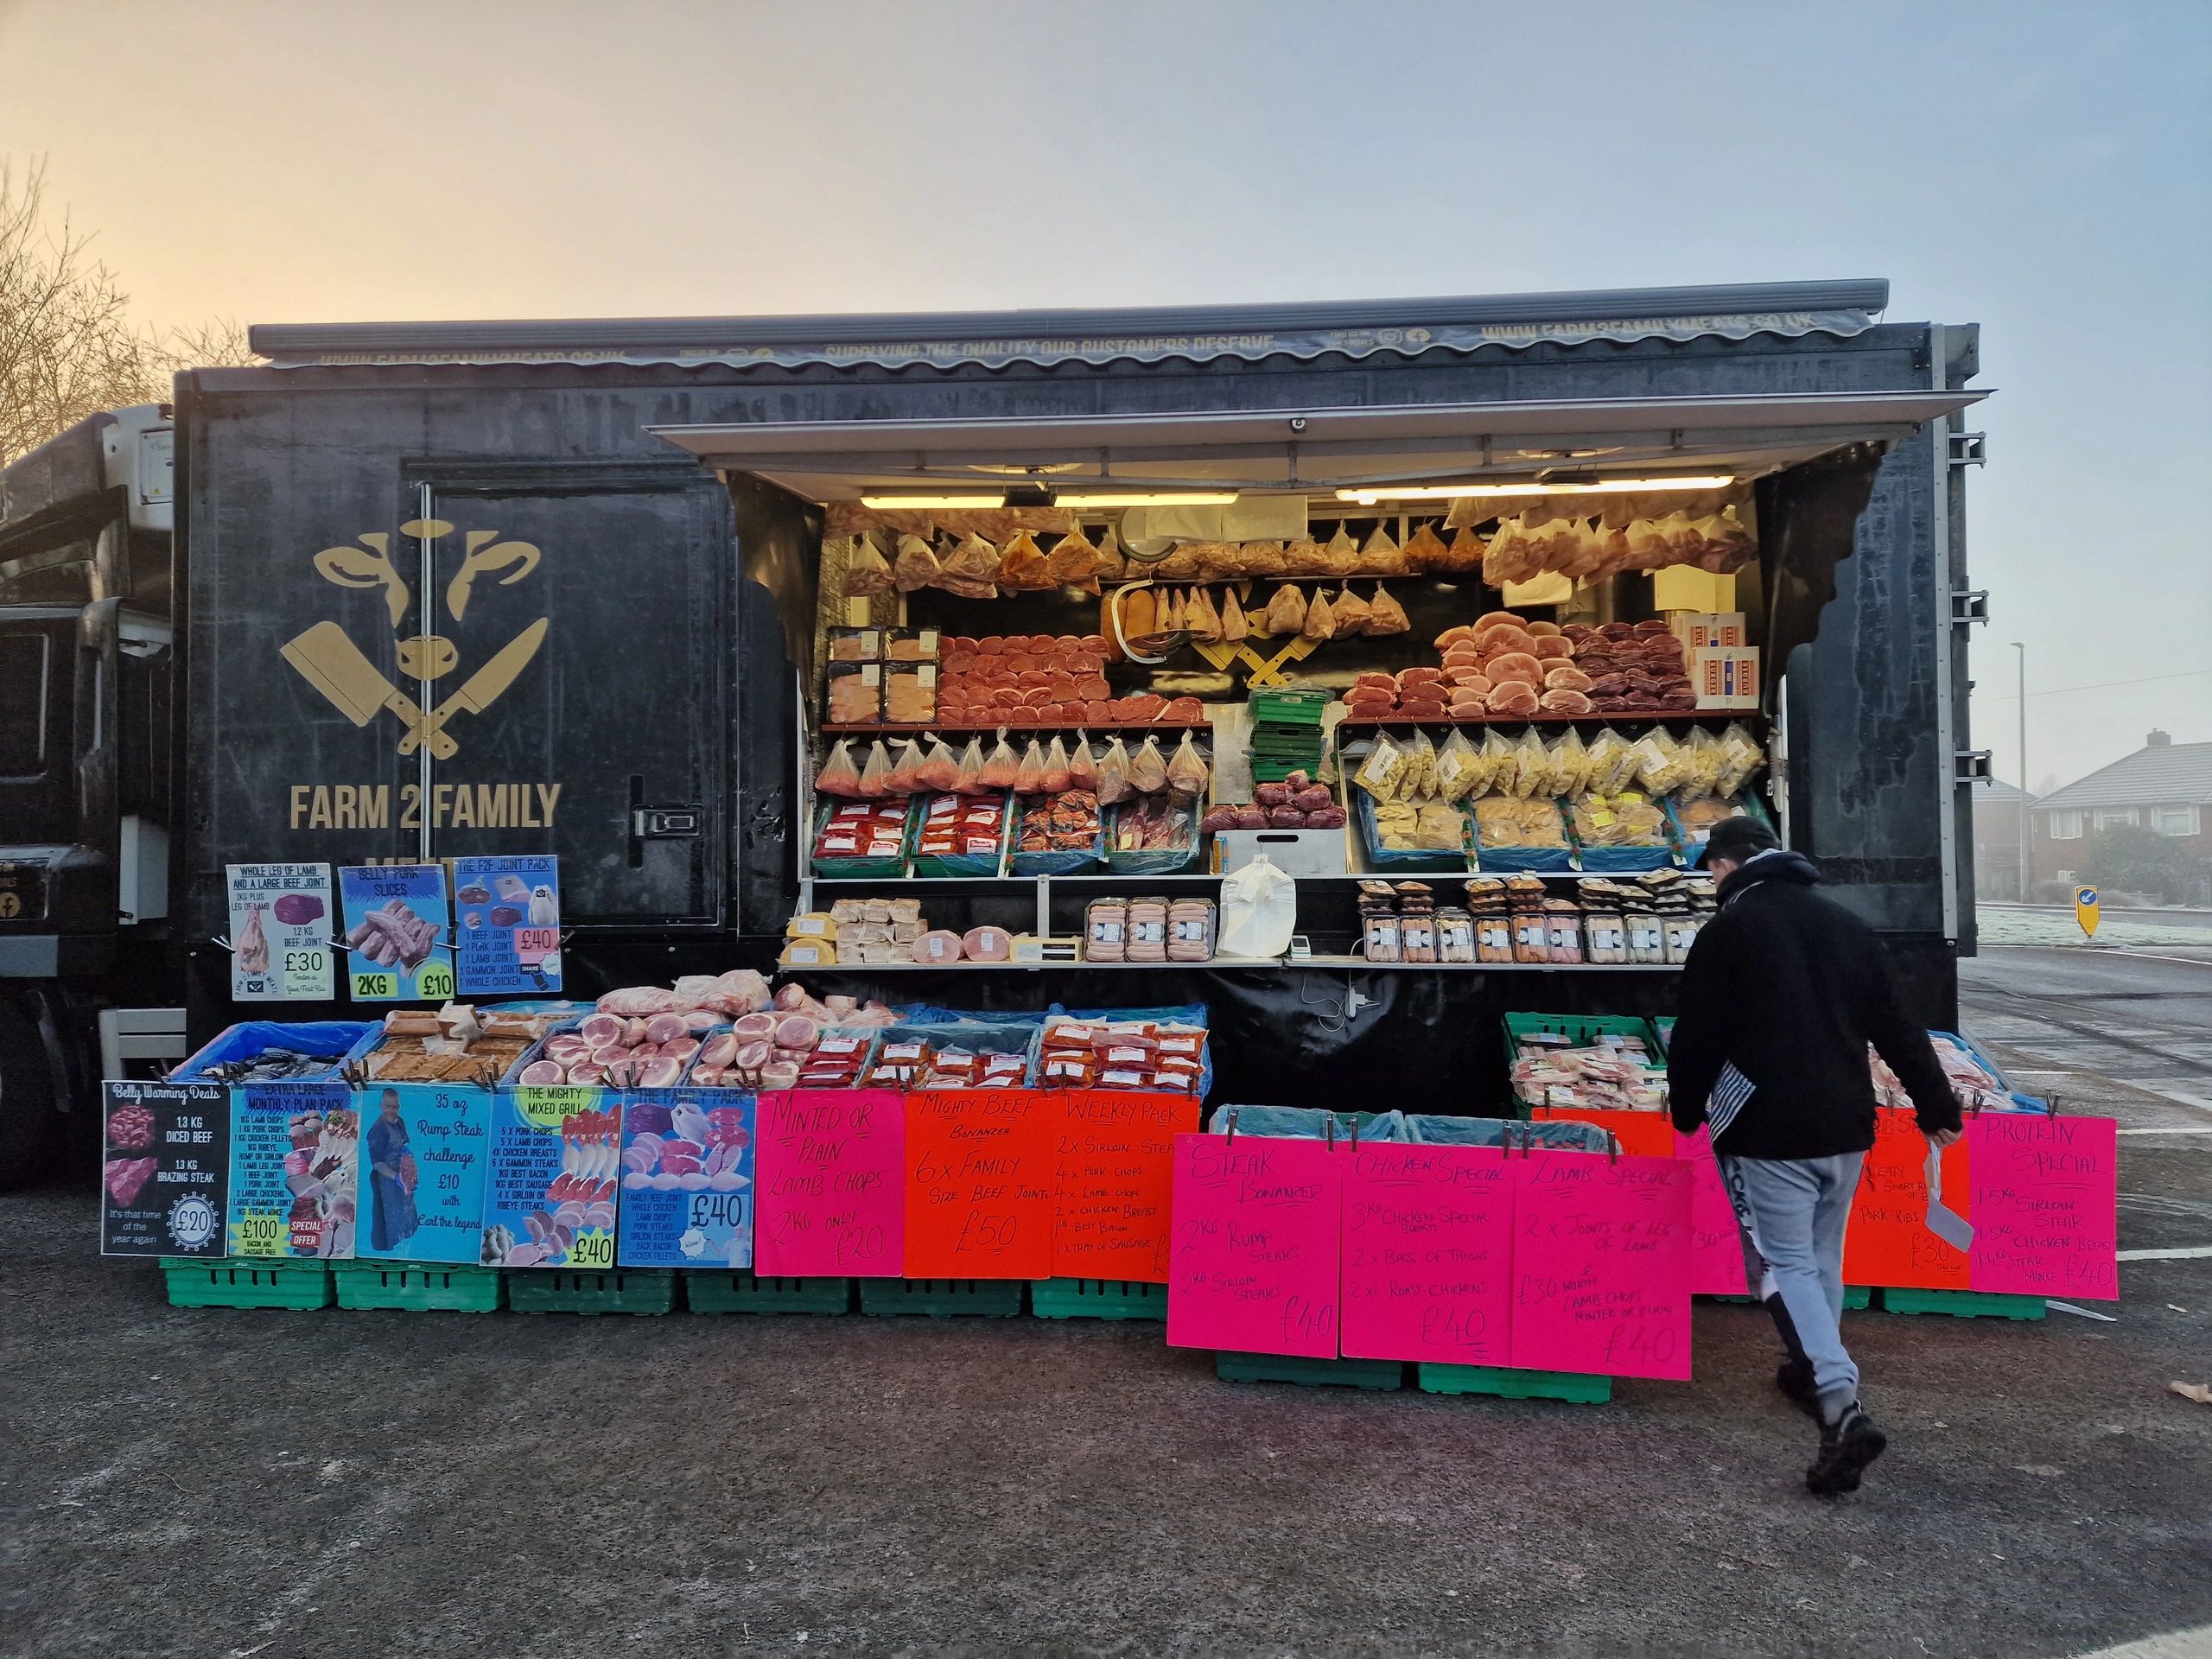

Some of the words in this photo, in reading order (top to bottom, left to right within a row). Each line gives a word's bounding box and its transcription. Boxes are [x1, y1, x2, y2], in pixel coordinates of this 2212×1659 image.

[825, 344, 919, 357] SUPPLYING
[925, 344, 957, 356] THE
[963, 341, 1036, 356] QUALITY
[1040, 340, 1076, 354] OUR
[1081, 338, 1189, 353] CUSTOMERS
[1193, 334, 1274, 350] DESERVE
[290, 785, 388, 830] FARM
[399, 784, 421, 830] 2
[432, 783, 562, 828] FAMILY
[240, 867, 264, 875] WHOLE
[269, 867, 282, 875] LEG
[284, 866, 294, 875] OF
[297, 866, 316, 875] LAMB
[457, 859, 474, 872] THE
[478, 859, 493, 871] F2F
[498, 859, 523, 870] JOINT
[528, 858, 550, 870] PACK
[233, 879, 247, 887] AND
[251, 879, 256, 887] A
[259, 879, 280, 887] LARGE
[284, 878, 301, 887] BEEF
[304, 878, 325, 887] JOINT
[374, 883, 408, 896] SLICES
[284, 938, 300, 947] BEEF
[302, 938, 322, 947] JOINT
[471, 931, 488, 939] BEEF
[492, 930, 512, 938] JOINT
[521, 930, 550, 950] £40
[285, 953, 322, 971] £30
[358, 975, 387, 995] 2KG
[423, 975, 452, 995] £10
[493, 977, 521, 986] CHICKEN
[112, 1084, 142, 1104] Belly
[143, 1084, 188, 1105] Warming
[189, 1085, 220, 1100] Deals
[527, 1088, 543, 1099] THE
[547, 1088, 582, 1099] MIGHTY
[248, 1098, 289, 1110] MONTHLY
[294, 1098, 316, 1110] PLAN
[320, 1098, 344, 1110] PACK
[435, 1094, 448, 1109] 35
[453, 1100, 468, 1116] oz
[528, 1103, 556, 1115] MIXED
[559, 1103, 582, 1115] GRILL
[768, 1091, 842, 1135] MINTED
[849, 1103, 876, 1129] OR
[919, 1093, 976, 1116] MIGHTY
[982, 1094, 1039, 1116] BEEF
[1067, 1094, 1136, 1126] WEEKLY
[1141, 1101, 1182, 1122] PACK
[191, 1116, 203, 1128] KG
[417, 1120, 451, 1141] Rump
[454, 1121, 484, 1136] Steak
[949, 1124, 1010, 1139] BONANZER
[1986, 1117, 2081, 1144] PROTEIN
[166, 1131, 189, 1143] DICED
[193, 1131, 213, 1143] BEEF
[423, 1147, 474, 1170] challenge
[502, 1148, 528, 1157] CHICKEN
[798, 1136, 849, 1163] PLAIN
[188, 1160, 198, 1170] KG
[958, 1149, 1020, 1178] FAMILY
[1190, 1143, 1276, 1179] STEAK
[1355, 1152, 1433, 1176] CHICKEN
[1433, 1153, 1505, 1185] SPECIAL
[2012, 1147, 2107, 1176] SPECIAL
[157, 1172, 188, 1182] BRAZING
[191, 1173, 214, 1183] STEAK
[438, 1174, 460, 1189] £10
[767, 1168, 823, 1196] LAMB
[833, 1170, 886, 1196] CHOPS
[1530, 1156, 1594, 1184] LAMB
[1604, 1166, 1673, 1188] SPECIAL
[442, 1196, 461, 1206] with
[928, 1187, 960, 1205] SIZE
[970, 1185, 1009, 1203] BEEF
[125, 1210, 140, 1218] that
[143, 1211, 161, 1219] time
[177, 1211, 208, 1231] £20
[690, 1195, 742, 1228] £40
[1860, 1205, 1888, 1224] PORK
[1896, 1209, 1919, 1224] RIBS
[2034, 1212, 2087, 1230] STEAK
[242, 1220, 277, 1239] £100
[291, 1221, 322, 1230] SPECIAL
[417, 1214, 438, 1227] Carl
[440, 1217, 453, 1227] the
[454, 1216, 482, 1234] legend
[651, 1223, 673, 1231] STEAKS
[955, 1210, 1017, 1253] £50
[111, 1235, 130, 1244] year
[133, 1236, 156, 1245] again
[294, 1235, 316, 1244] OFFER
[834, 1224, 883, 1266] £20
[572, 1238, 612, 1263] £40
[1910, 1233, 1948, 1269] £30
[2065, 1254, 2113, 1287] £40
[1279, 1296, 1333, 1344] £40
[1420, 1306, 1486, 1346] £40
[1605, 1325, 1675, 1365] £40
